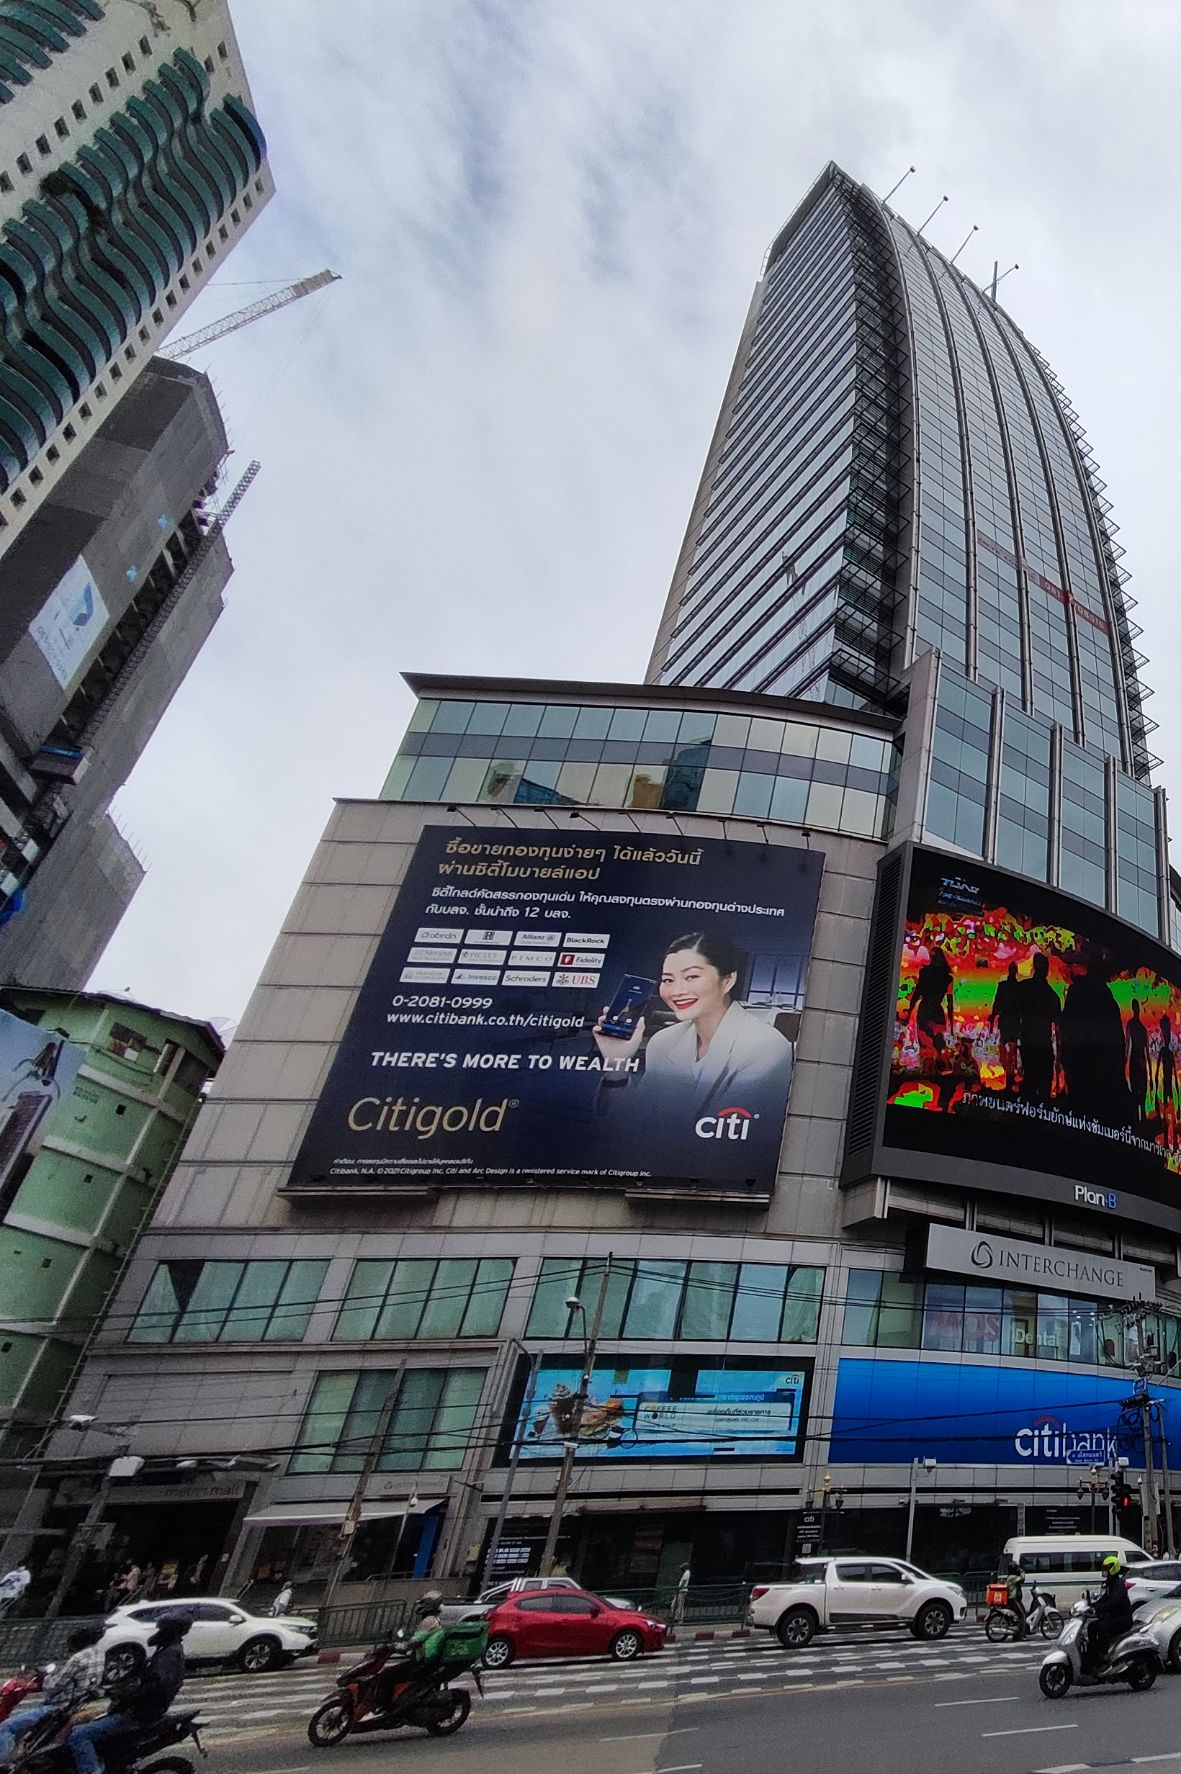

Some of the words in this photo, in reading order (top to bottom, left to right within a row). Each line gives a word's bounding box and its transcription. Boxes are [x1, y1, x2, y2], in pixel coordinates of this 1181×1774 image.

[524, 906, 539, 918] 12
[576, 956, 602, 964] Fidelity
[505, 974, 547, 983] Schroders
[572, 975, 596, 985] UBS
[392, 995, 493, 1009] 0-2081-0999
[386, 1011, 585, 1030] www.citibank.co.th/citigold
[370, 1051, 457, 1068] THERE'S
[462, 1053, 521, 1069] MORE
[527, 1054, 553, 1070] TO
[559, 1055, 640, 1073] WEALTH
[1000, 1249, 1124, 1287] INTERCHANGE
